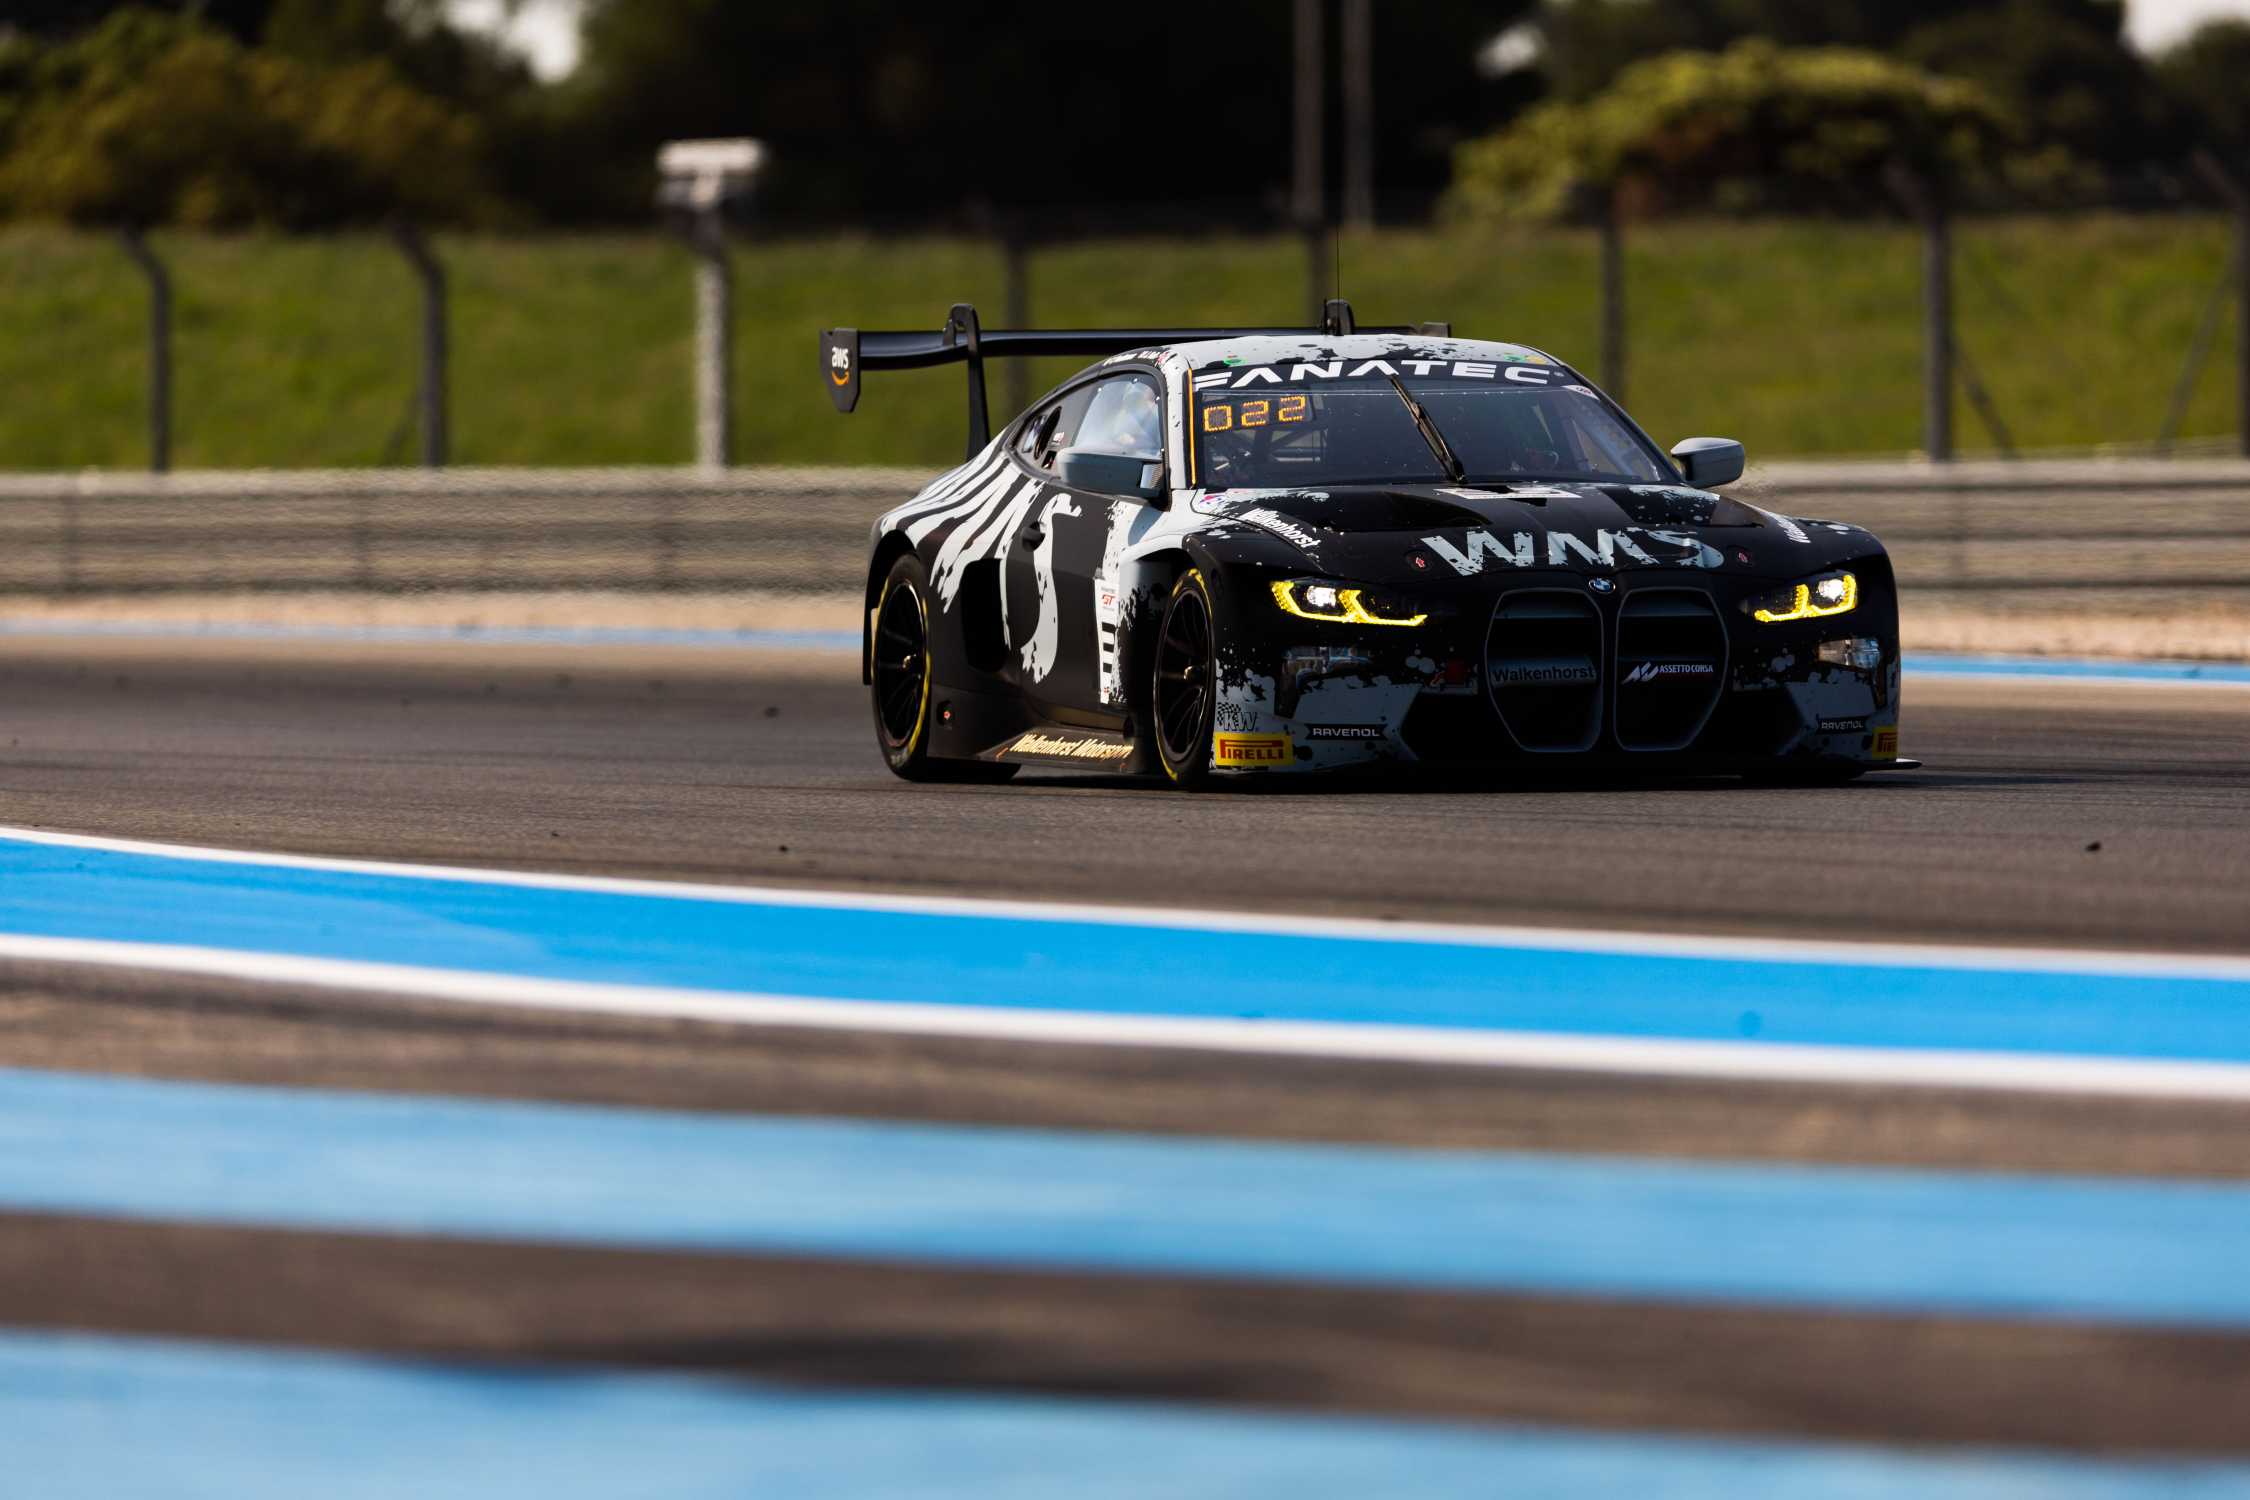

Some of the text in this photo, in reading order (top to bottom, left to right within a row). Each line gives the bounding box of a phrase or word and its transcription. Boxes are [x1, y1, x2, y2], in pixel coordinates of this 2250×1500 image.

[832, 345, 849, 369] aws
[1192, 359, 1551, 392] FANATEC
[1203, 394, 1306, 432] 022
[1493, 664, 1595, 682] Walkenhorst
[1659, 664, 1714, 673] ASSETTO CORSA
[1223, 711, 1257, 731] KW
[1312, 727, 1380, 737] RAVENOL
[1220, 739, 1284, 759] PIRELLI
